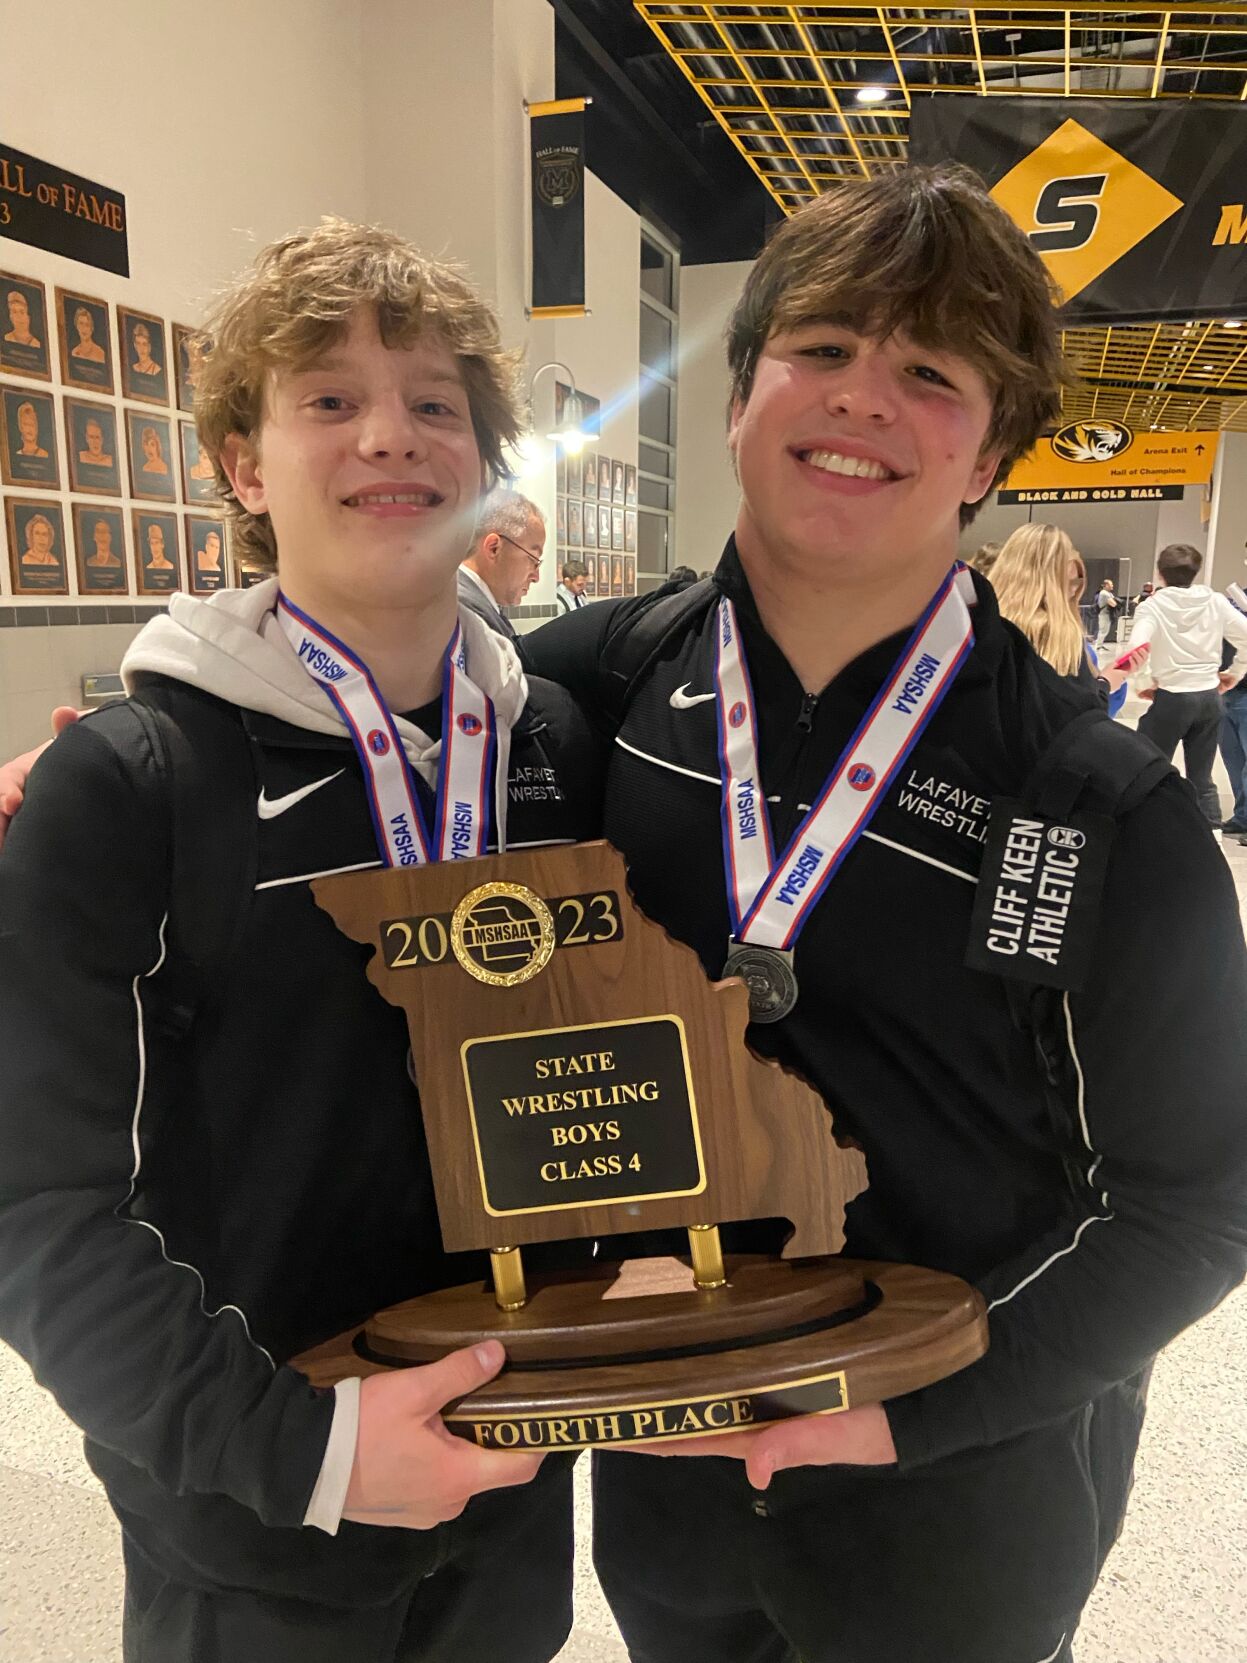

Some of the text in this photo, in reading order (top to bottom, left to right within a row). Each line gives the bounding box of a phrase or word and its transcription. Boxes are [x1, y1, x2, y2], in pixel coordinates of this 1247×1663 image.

[0, 159, 124, 232] LL OF FAME
[1028, 173, 1109, 254] S
[1140, 467, 1186, 477] Champions
[1143, 447, 1168, 455] Arena
[1018, 488, 1163, 502] BLACK AND GOLD HALL
[298, 637, 348, 682] MSHSAA
[892, 653, 941, 715] MSHSAA
[738, 778, 757, 840] MSHSAA
[390, 813, 418, 865] SHSAA
[775, 844, 824, 906] MSHSAA
[986, 818, 1045, 955] CLIFF KEEN
[386, 895, 618, 968] 20 23
[1026, 850, 1080, 966] ATHLETIC
[475, 922, 529, 945] MSHSAA
[535, 1051, 615, 1079] STATE
[502, 1081, 659, 1117] WRESTLING
[551, 1120, 621, 1147] BOYS
[540, 1152, 642, 1182] CLASS 4
[473, 1398, 754, 1447] FOURTH PLACE
